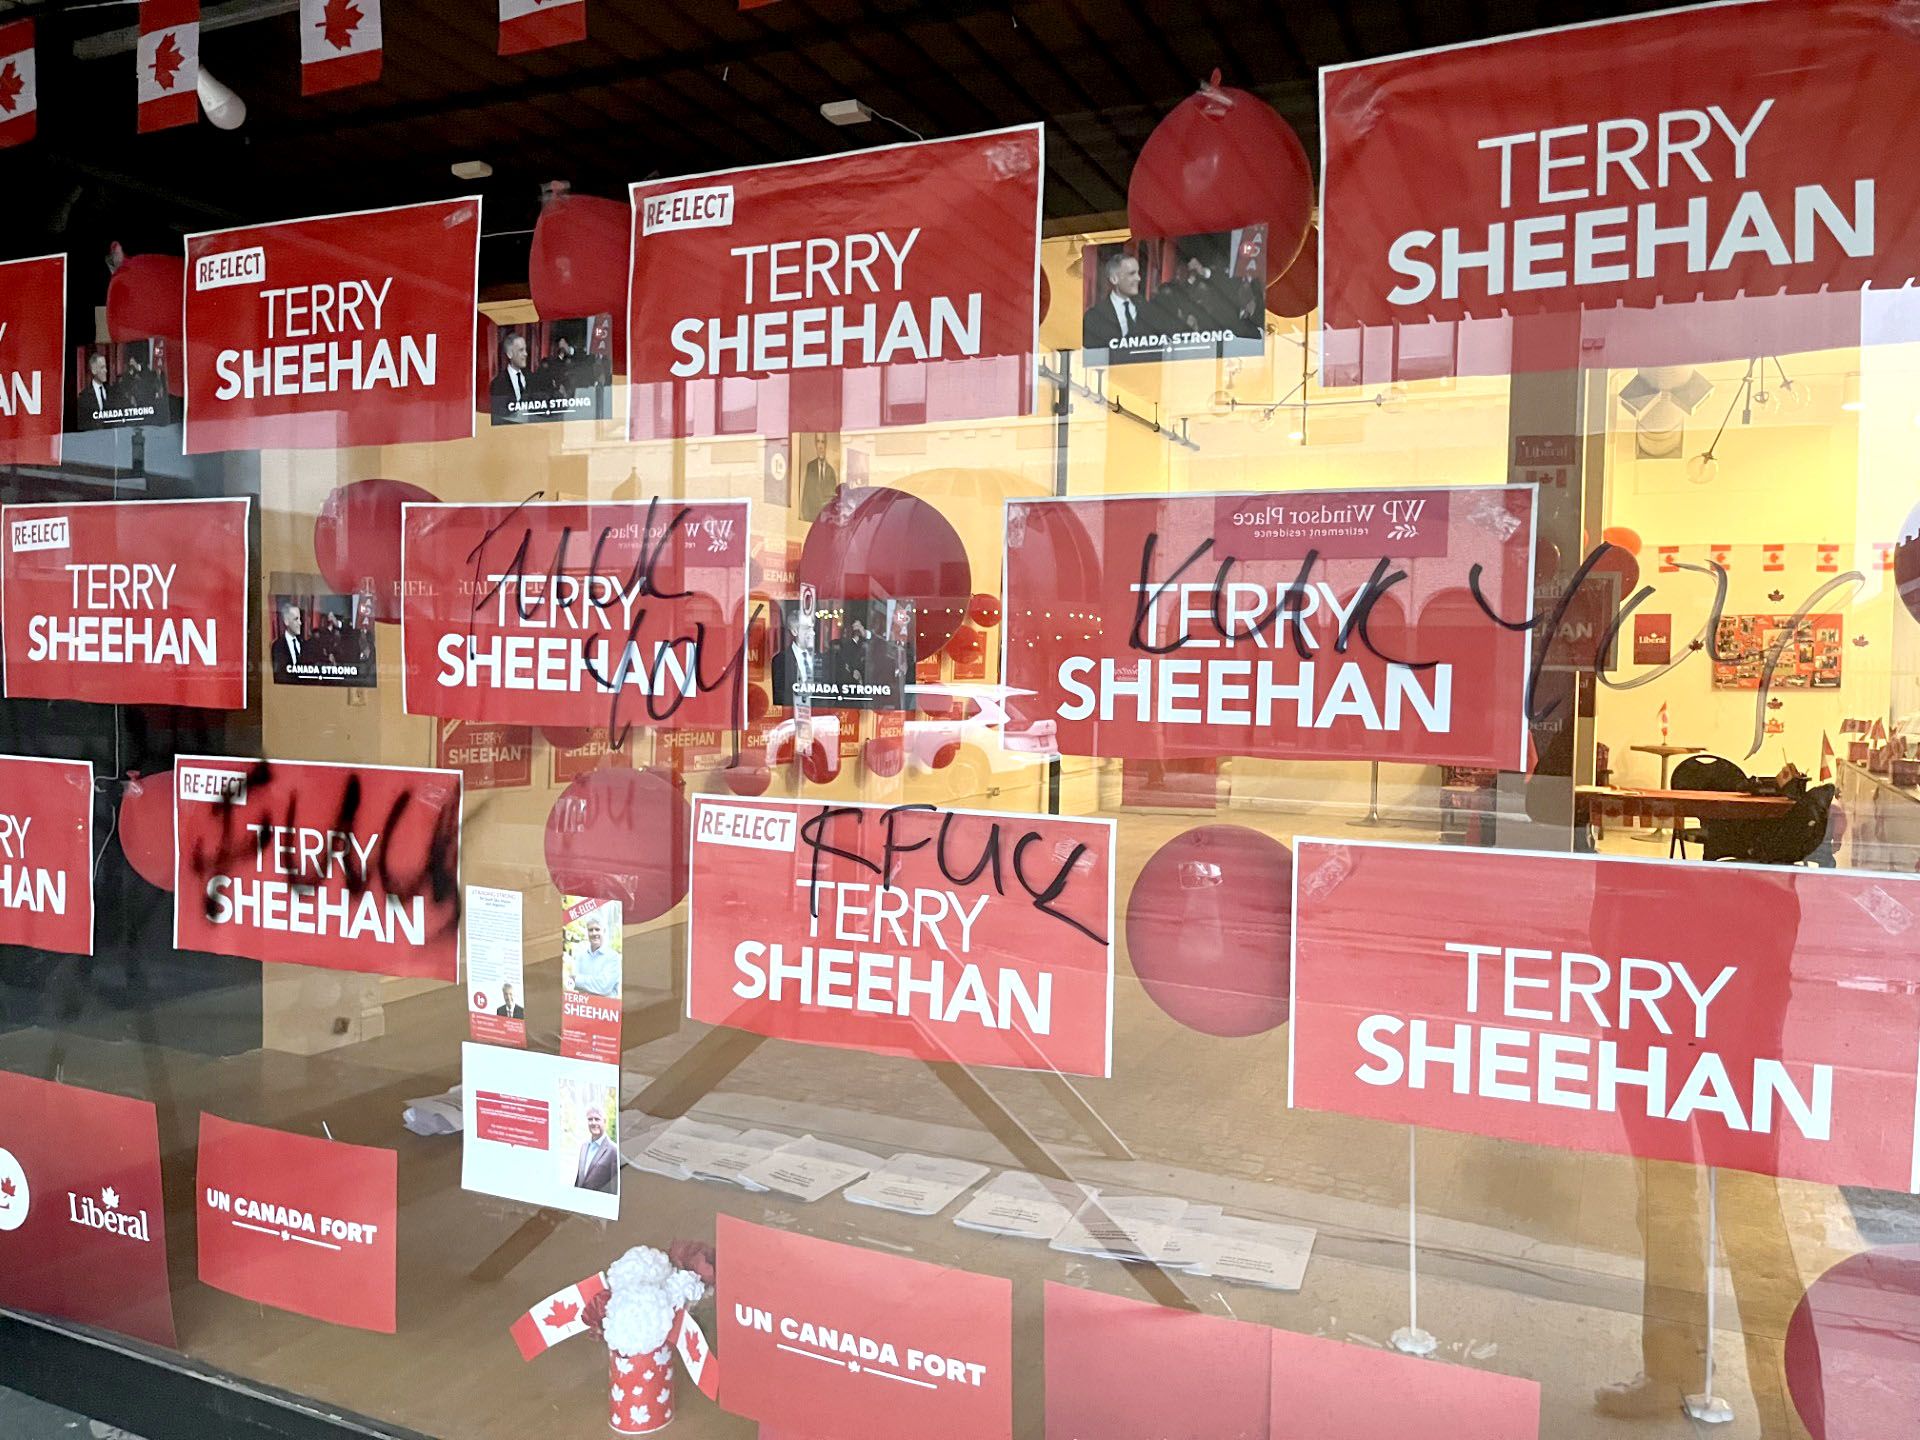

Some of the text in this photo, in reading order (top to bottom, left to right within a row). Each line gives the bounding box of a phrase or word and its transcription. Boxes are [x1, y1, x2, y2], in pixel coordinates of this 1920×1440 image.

[1478, 99, 1774, 208] TERRY
[646, 193, 729, 226] RE-ELECT
[731, 228, 920, 303] TERRY
[1387, 179, 1874, 305] SHEEHAN
[200, 252, 261, 284] RE-ELECT
[260, 277, 393, 339] TERRY
[670, 293, 982, 377] SHEEHAN
[1109, 330, 1234, 349] CANADA STRONG
[216, 334, 437, 401] SHEEHAN
[93, 407, 154, 419] CANADA STRONG
[508, 397, 591, 411] CANADA STRONG
[14, 522, 66, 546] RE-ELECT
[66, 563, 176, 610] TERRY
[487, 573, 646, 631] TERRY
[28, 616, 217, 665] SHEEHAN
[1130, 583, 1367, 649] TERRY
[1639, 635, 1666, 644] Liberal
[287, 664, 320, 675] CANADA
[321, 665, 358, 677] STRONG
[437, 633, 696, 698] SHEEHAN
[792, 683, 891, 695] CANADA STRONG
[1057, 657, 1452, 733] SHEEHAN
[449, 748, 521, 764] SHEEHAN
[663, 732, 715, 748] SHEEHAN
[184, 773, 245, 798] RE-ELECT
[701, 811, 790, 842] RE-ELECT
[246, 823, 378, 881] TERRY
[206, 875, 425, 946] SHEEHAN
[569, 899, 597, 920] RE-ELECT
[796, 879, 989, 953] TERRY
[564, 993, 589, 1004] TERRY
[732, 940, 1052, 1035] SHEEHAN
[1445, 942, 1738, 1038] TERRY
[564, 1004, 619, 1022] SHEEHAN
[1354, 1014, 1833, 1140] SHEEHAN
[68, 1191, 150, 1241] Liberal
[207, 1188, 377, 1245] UN CANADA FORT
[735, 1303, 986, 1387] UN CANADA FORT
